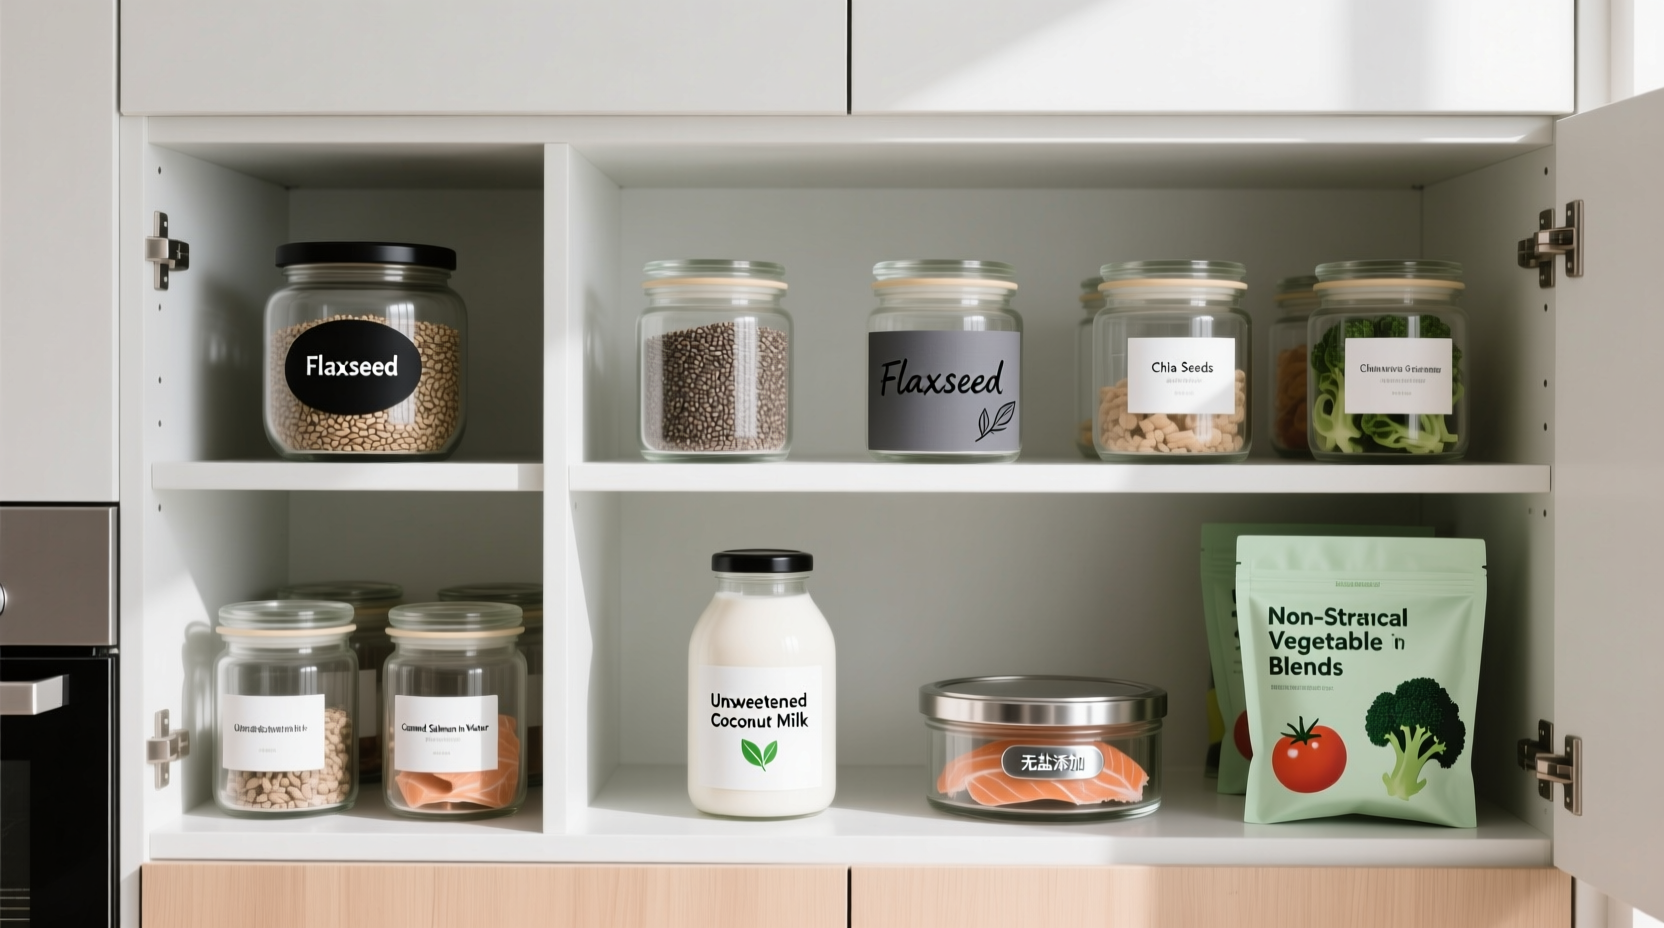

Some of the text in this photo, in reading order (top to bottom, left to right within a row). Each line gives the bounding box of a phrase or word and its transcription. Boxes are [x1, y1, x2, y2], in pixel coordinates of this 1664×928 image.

[306, 354, 398, 377] Flaxseed
[1151, 361, 1214, 373] Chia Seeds
[880, 358, 1004, 396] Flaxseed
[1268, 630, 1383, 656] Vegetable
[1269, 656, 1343, 677] Blends
[711, 711, 809, 728] Coconut Milk
[1021, 753, 1085, 771] 无盐添加
